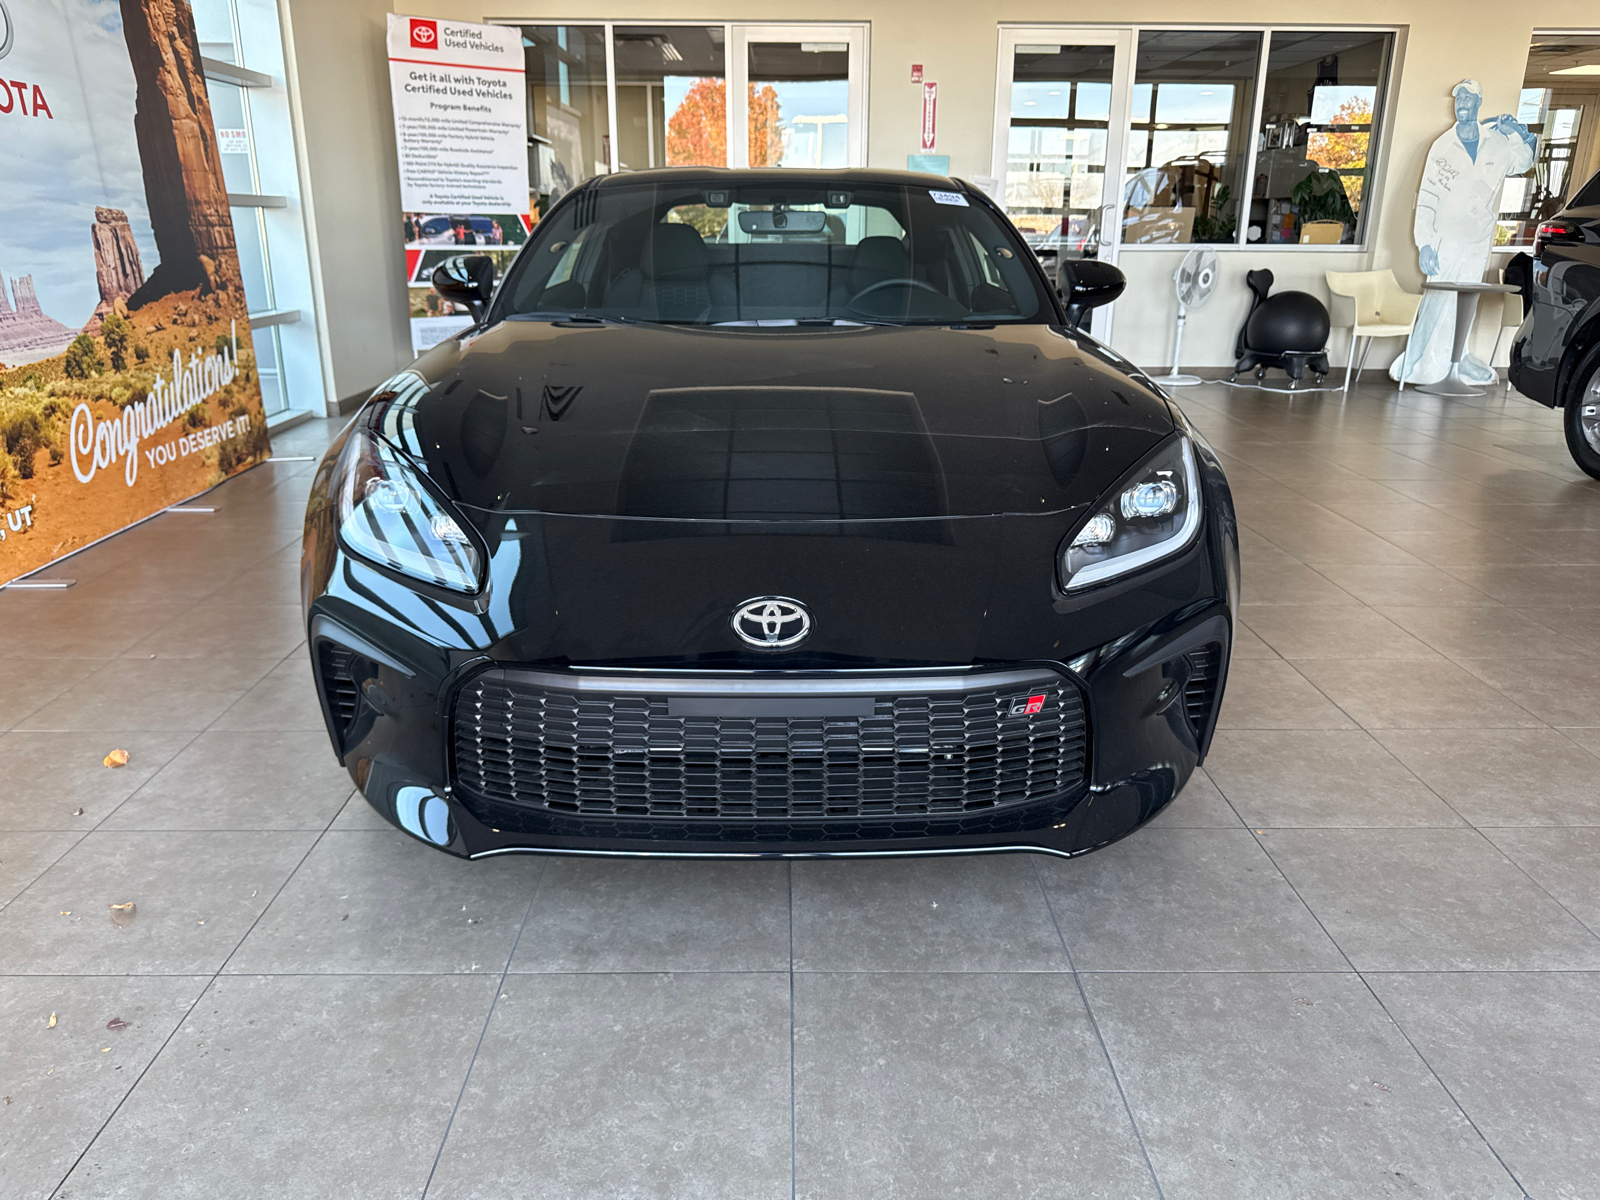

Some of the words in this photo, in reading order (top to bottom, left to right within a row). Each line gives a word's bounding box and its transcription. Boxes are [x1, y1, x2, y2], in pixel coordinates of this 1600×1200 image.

[444, 27, 482, 39] Certified
[445, 38, 467, 49] Used
[469, 41, 504, 53] Vehicles
[409, 71, 428, 81] Get
[430, 72, 437, 82] it
[439, 74, 452, 84] all
[453, 74, 475, 86] with
[476, 76, 507, 88] Toyota
[404, 83, 448, 95] Certified
[449, 86, 473, 97] Used
[475, 88, 513, 100] Vehicles
[430, 102, 462, 112] Program
[463, 104, 492, 113] Benefits
[70, 319, 240, 487] Congratulations!
[146, 441, 176, 468] YOU
[178, 422, 236, 457] DESERVE
[236, 414, 251, 434] IT!
[7, 505, 32, 533] UT
[1011, 702, 1041, 715] GR
